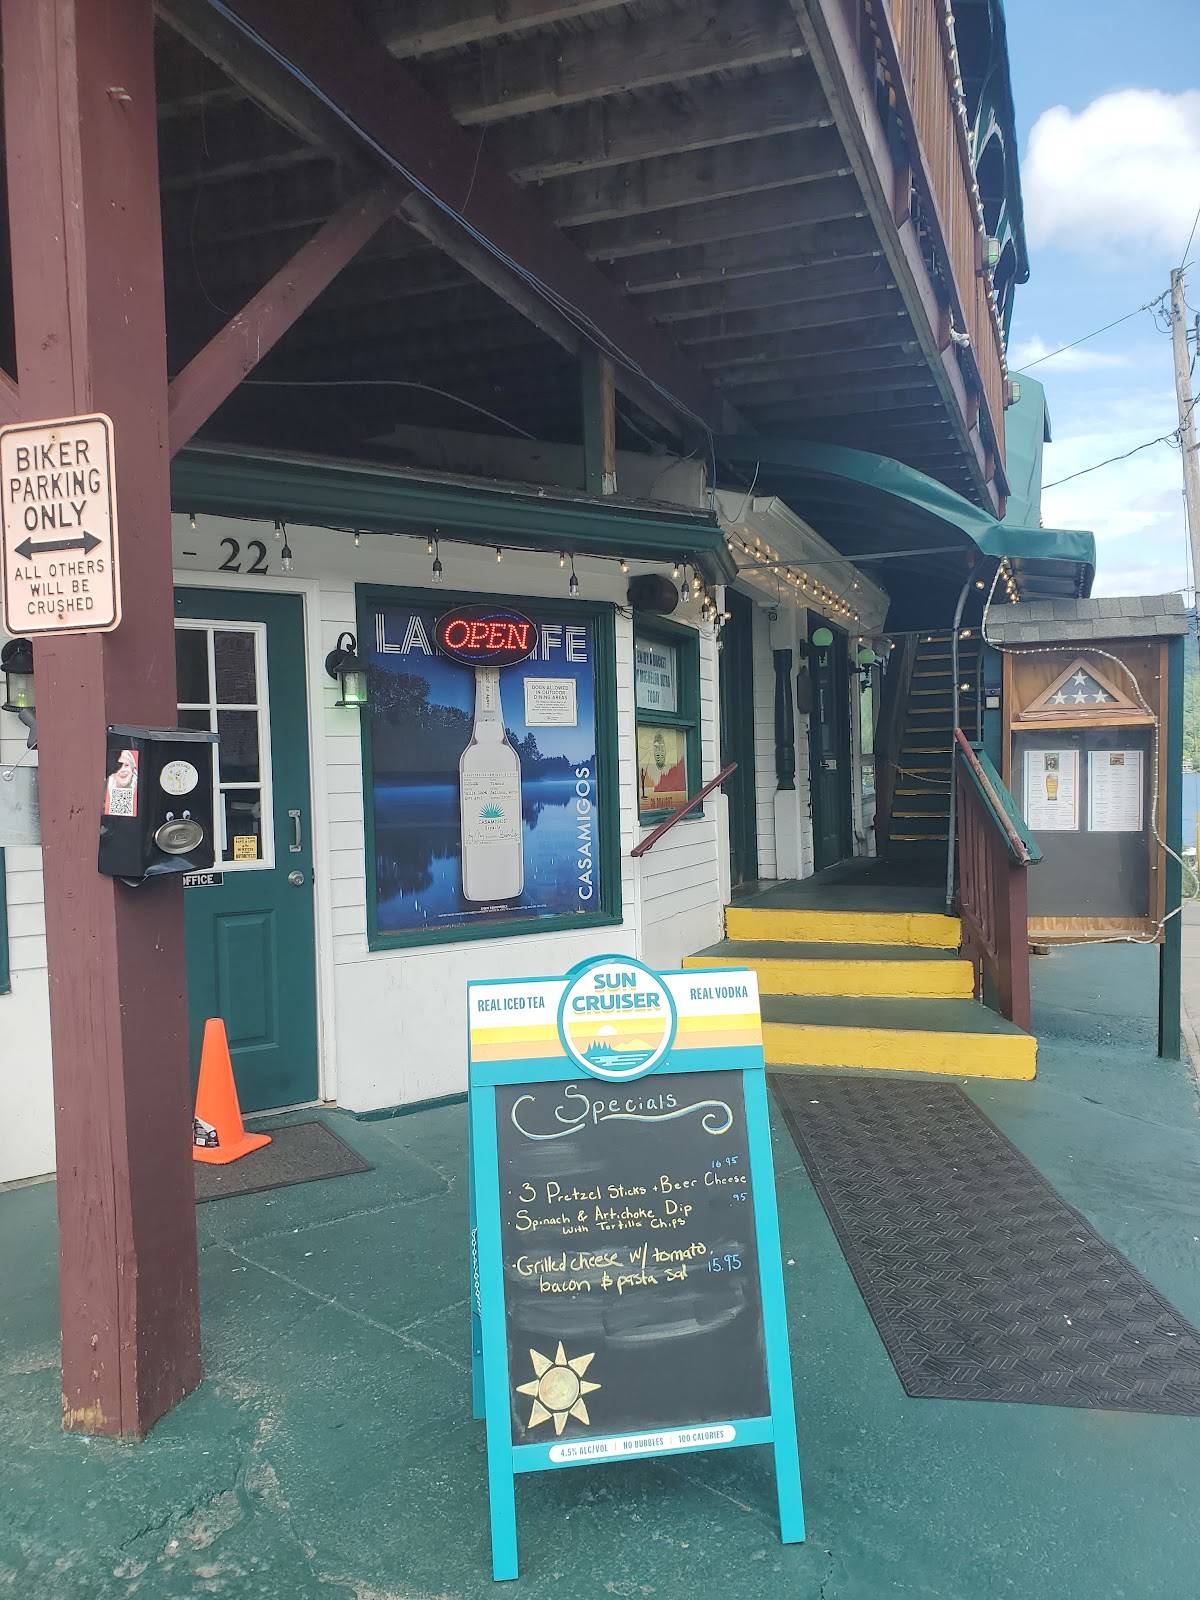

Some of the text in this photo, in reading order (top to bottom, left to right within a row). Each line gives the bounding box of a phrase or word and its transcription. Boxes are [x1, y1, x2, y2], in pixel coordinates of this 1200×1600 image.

[17, 439, 90, 473] BIKER
[10, 468, 101, 504] PARKING
[24, 500, 87, 531] ONLY
[218, 537, 269, 576] 22
[15, 559, 105, 581] ALL OTHERS
[30, 579, 90, 597] WILL BE
[27, 596, 94, 615] CRUSHED
[444, 620, 530, 650] OPEN
[576, 767, 593, 900] CASAMIGOS
[593, 973, 637, 992] SUN
[690, 985, 748, 1000] REAL VODKA
[477, 996, 545, 1012] REAL ICED TEA
[572, 992, 661, 1014] CRUISER
[554, 1084, 677, 1124] Specials
[518, 1183, 536, 1203] 3
[546, 1181, 602, 1204] Pretzel
[607, 1184, 647, 1200] Sticks
[704, 1171, 747, 1187] Cheese
[515, 1199, 693, 1231] Spinach & Artichoke Dip
[595, 1220, 642, 1232] Tortilla
[650, 1217, 686, 1230] Chips
[516, 1251, 567, 1277] Grilled
[570, 1251, 624, 1270] cheese
[707, 1253, 742, 1274] 15.95
[539, 1273, 591, 1293] bacon
[616, 1270, 658, 1296] pasta
[560, 1430, 725, 1458] 4.5% ALC/VOL NO BUBBLES 100 CALORIES
